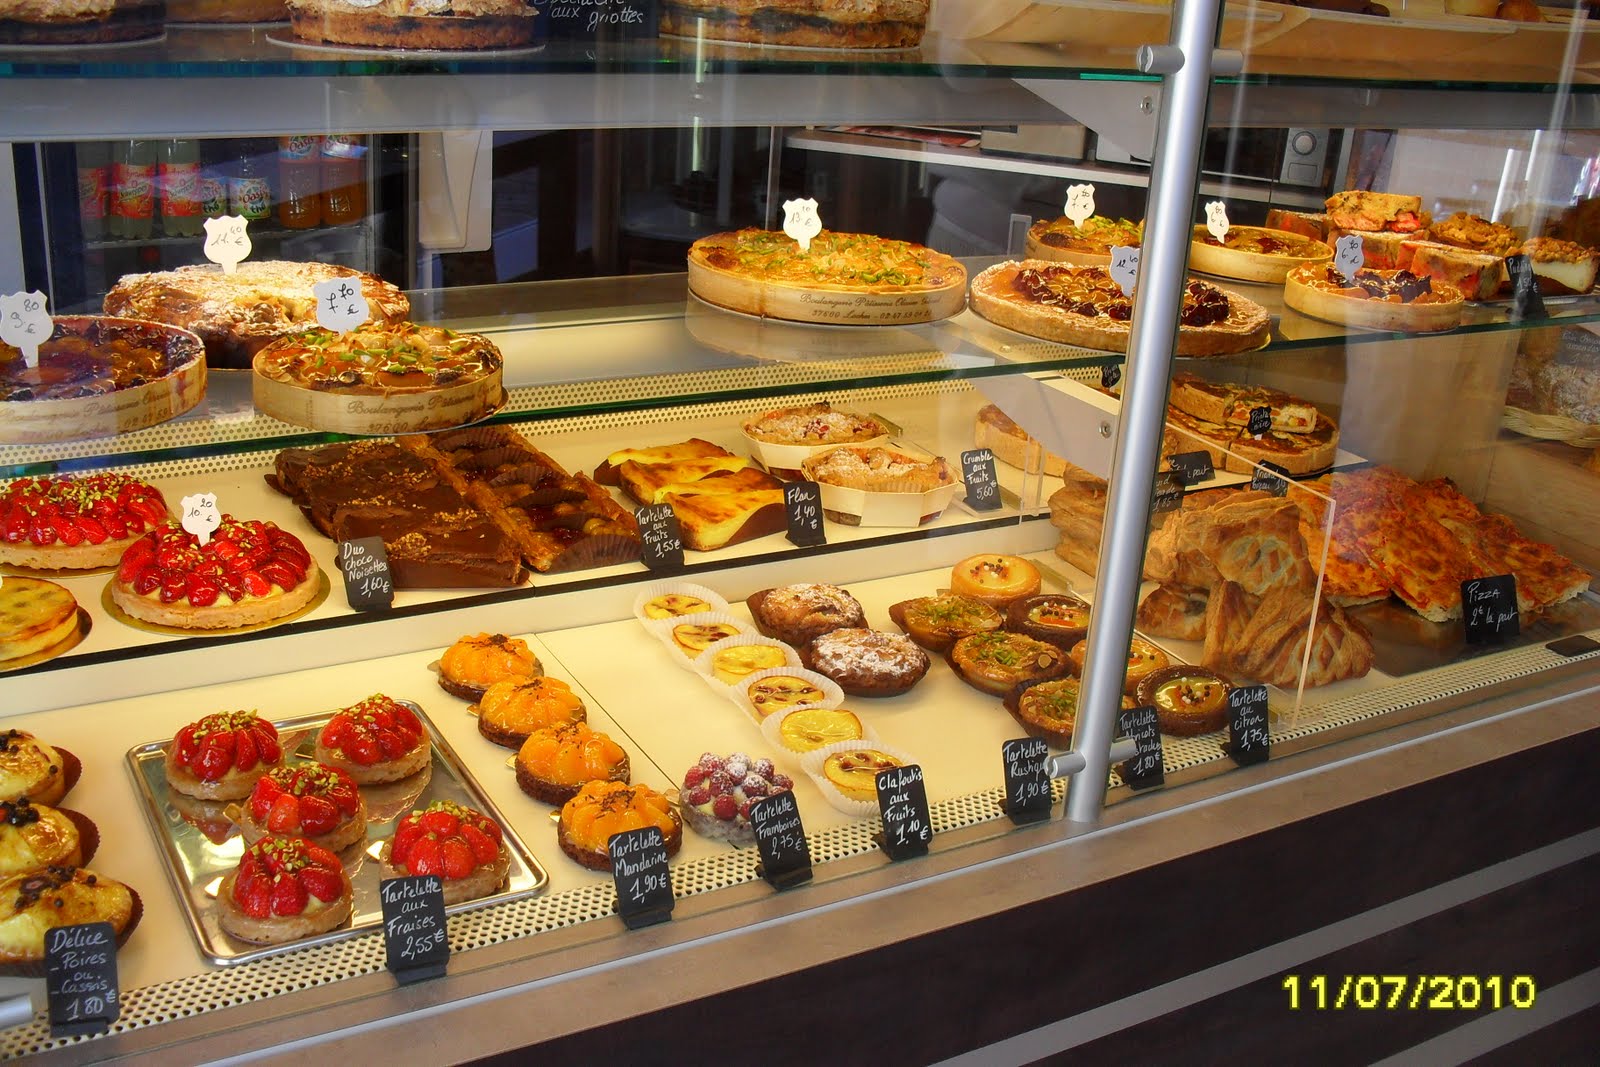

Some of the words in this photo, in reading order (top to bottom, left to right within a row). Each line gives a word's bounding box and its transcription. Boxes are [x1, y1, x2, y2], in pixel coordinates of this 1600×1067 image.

[551, 6, 581, 18] aux
[586, 5, 643, 32] griottes
[289, 137, 314, 152] Oasis
[243, 187, 269, 204] Oasis
[963, 450, 993, 464] Crumble
[973, 463, 986, 473] aux
[966, 470, 989, 485] Fruits
[788, 487, 816, 505] Flan
[636, 506, 674, 525] Tartelette
[653, 520, 667, 530] aux
[643, 530, 668, 544] Fruits
[343, 542, 365, 559] Duo
[1496, 606, 1518, 632] part
[1229, 688, 1268, 707] Tartelette
[1240, 705, 1254, 716] au
[1120, 709, 1157, 731] Tartelette
[1003, 741, 1048, 764] Tartelette
[878, 768, 922, 794] Clafoutis
[889, 792, 910, 805] aux
[751, 797, 794, 823] Tartelette
[883, 804, 915, 822] Fruits
[756, 818, 800, 840] Framboises
[608, 830, 662, 858] Tartelette
[615, 851, 668, 877] Mandarine
[382, 877, 441, 903] Tartelette
[402, 900, 429, 914] aux
[387, 914, 436, 938] Fraises
[50, 926, 109, 954] Délice
[74, 972, 94, 981] ou
